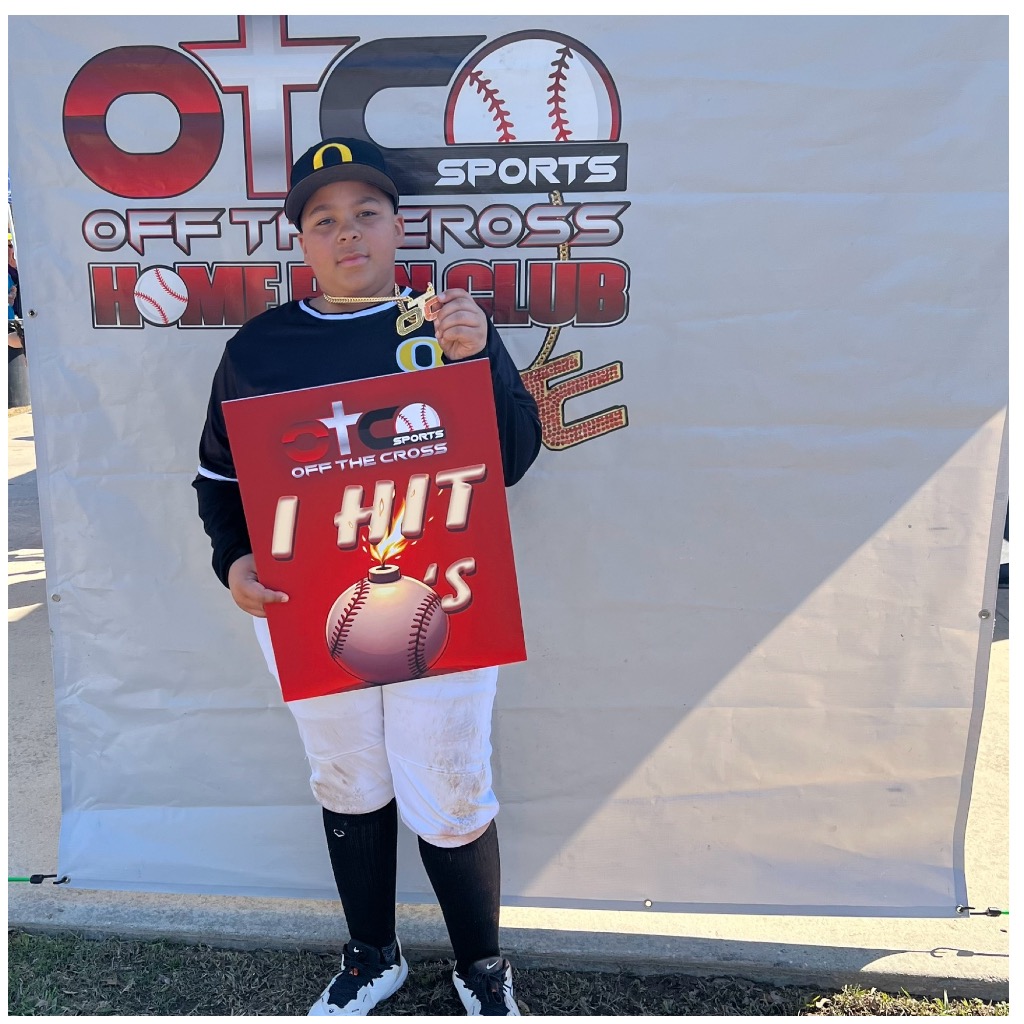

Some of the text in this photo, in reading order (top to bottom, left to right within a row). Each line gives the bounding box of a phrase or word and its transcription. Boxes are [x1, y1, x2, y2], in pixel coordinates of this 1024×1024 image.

[434, 156, 621, 187] SPORTS
[82, 208, 226, 256] OFF
[442, 258, 631, 328] CLUB
[393, 429, 444, 447] SPORTS
[291, 442, 448, 479] OFF THE CROSS
[271, 464, 488, 560] I HIT
